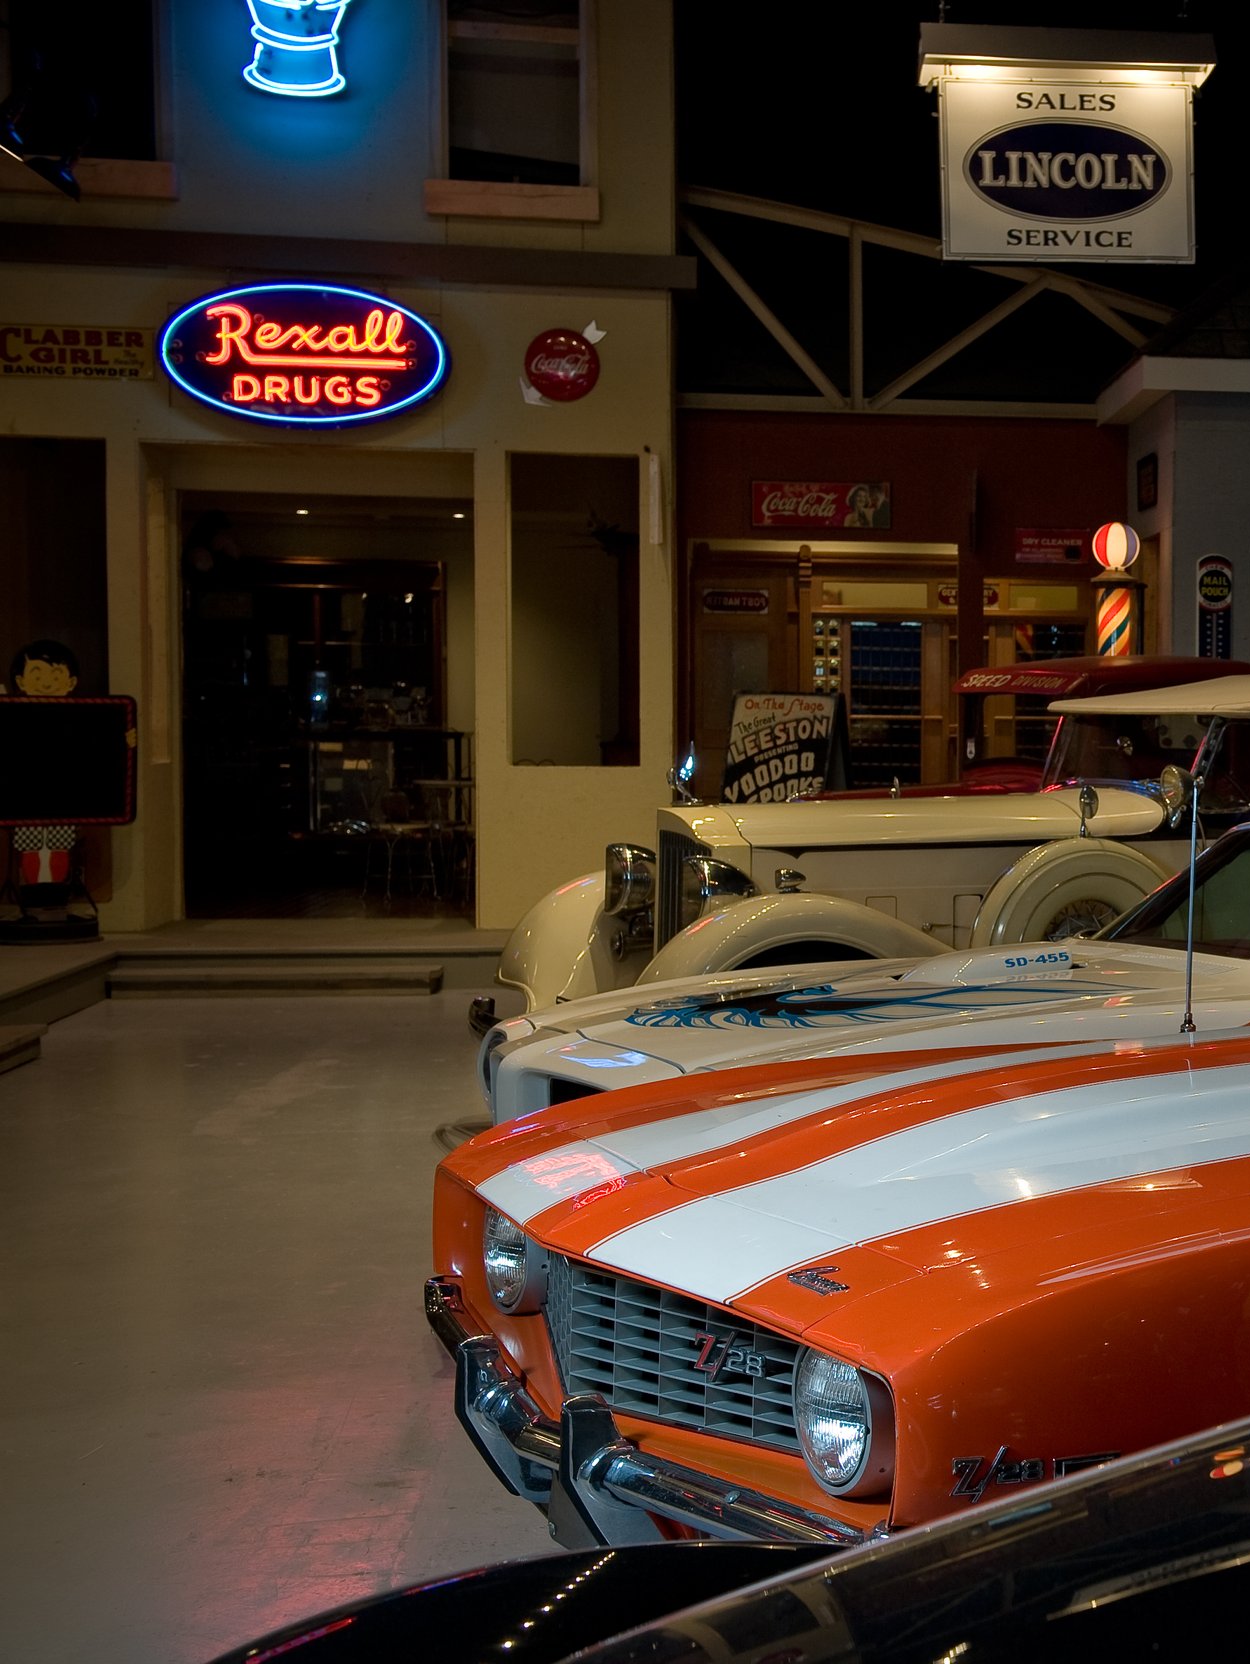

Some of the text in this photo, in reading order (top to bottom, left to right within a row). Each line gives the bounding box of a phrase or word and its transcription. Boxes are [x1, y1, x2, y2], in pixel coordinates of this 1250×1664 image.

[1016, 92, 1116, 111] SALES
[977, 150, 1157, 190] LINCOLN
[1006, 228, 1133, 248] SERVICE
[0, 327, 144, 362] CLABBER
[206, 303, 408, 370] Rexall
[30, 347, 109, 365] GIRL
[3, 365, 139, 377] BAKING POWDER
[232, 375, 382, 406] DRUGS
[761, 491, 840, 518] Coca-Cola
[1200, 587, 1229, 597] POUCH
[1203, 576, 1228, 586] MAIL
[960, 673, 1068, 689] SPEED DIVISION
[744, 698, 824, 717] On The Stage
[734, 712, 776, 735] The Great
[730, 715, 830, 765] LEESTON
[724, 751, 815, 803] VOODOO
[1004, 951, 1069, 968] SD-455
[693, 1331, 765, 1382] Z/28
[949, 1445, 1043, 1504] Z/28
